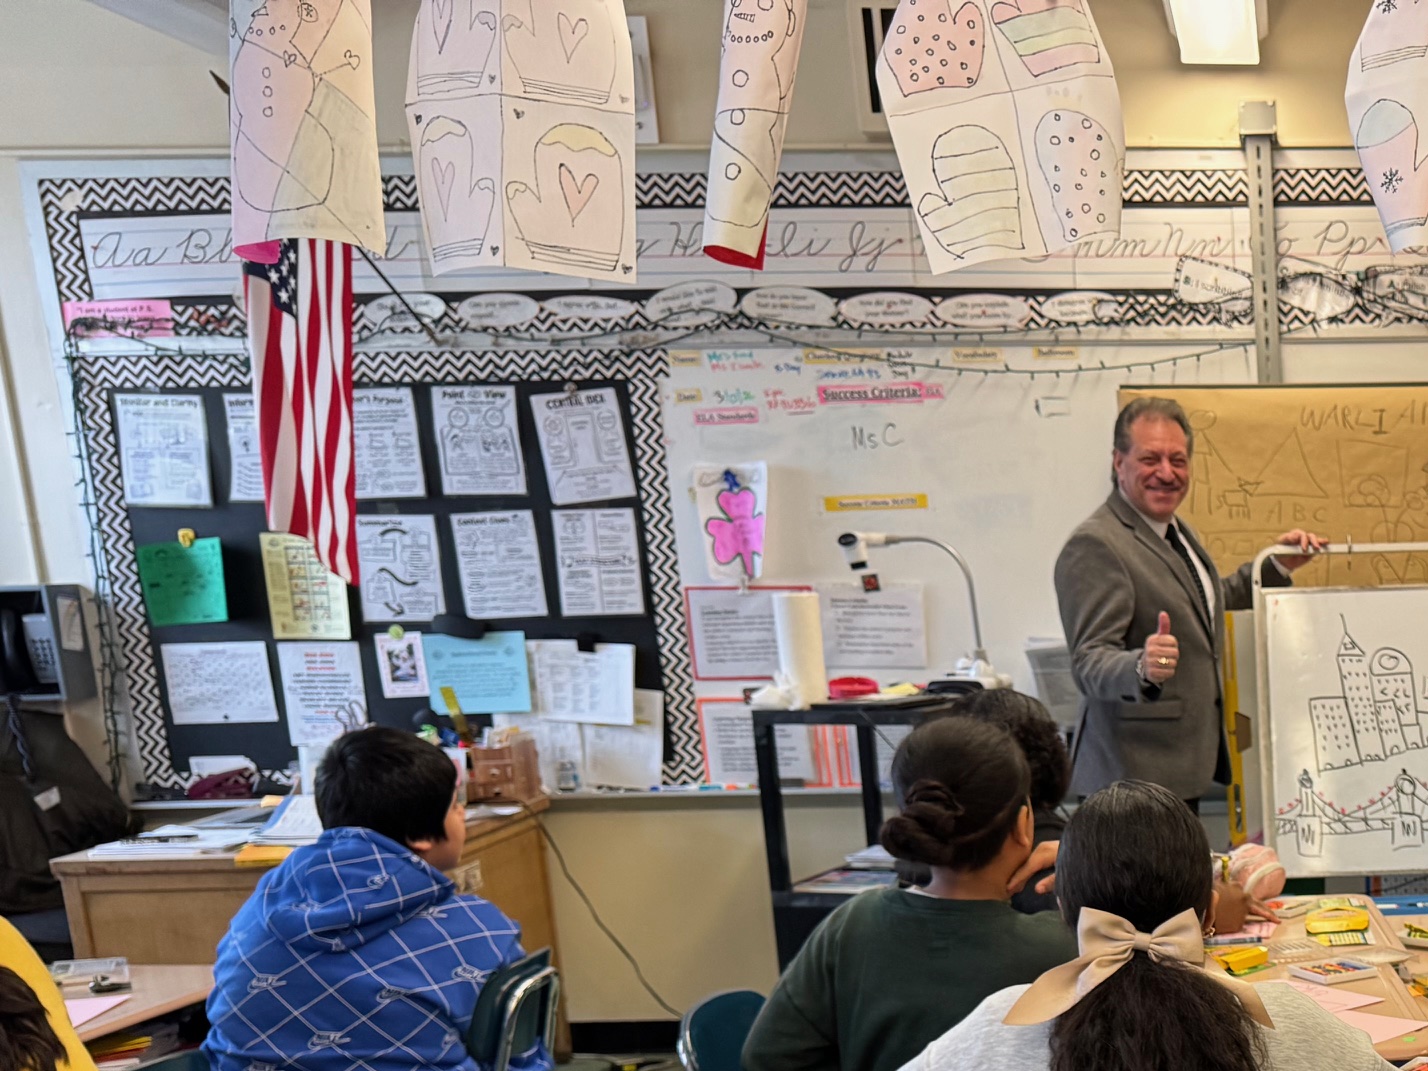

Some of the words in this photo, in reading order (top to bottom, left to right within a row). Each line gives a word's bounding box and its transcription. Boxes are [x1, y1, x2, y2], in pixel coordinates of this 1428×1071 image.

[484, 390, 506, 399] View
[822, 388, 869, 400] Success
[871, 386, 922, 398] Criteria:
[154, 399, 167, 407] and
[1301, 404, 1388, 434] WARLI
